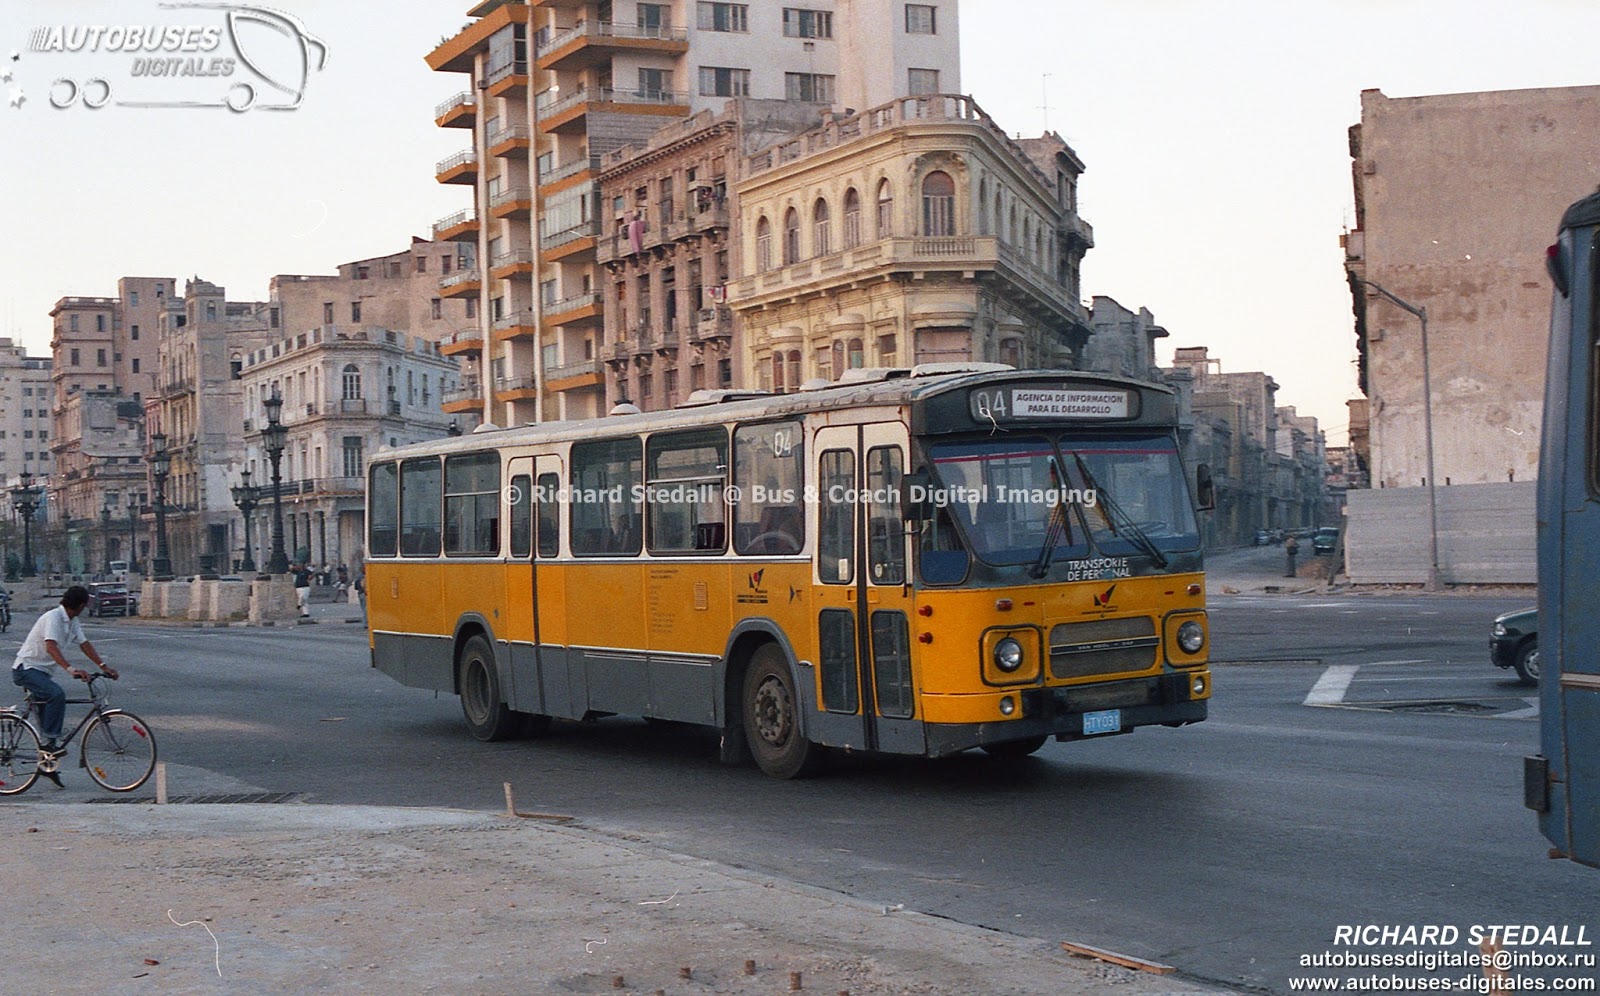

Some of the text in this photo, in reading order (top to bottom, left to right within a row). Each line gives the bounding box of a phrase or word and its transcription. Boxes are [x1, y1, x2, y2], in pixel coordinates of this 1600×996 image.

[1016, 393, 1123, 404] AGENCIA DE INFORMACION
[1028, 404, 1112, 414] PARA EL DESARROLLO
[774, 430, 791, 456] 04
[1068, 557, 1128, 570] TRANSPORTE
[1067, 571, 1081, 581] DE
